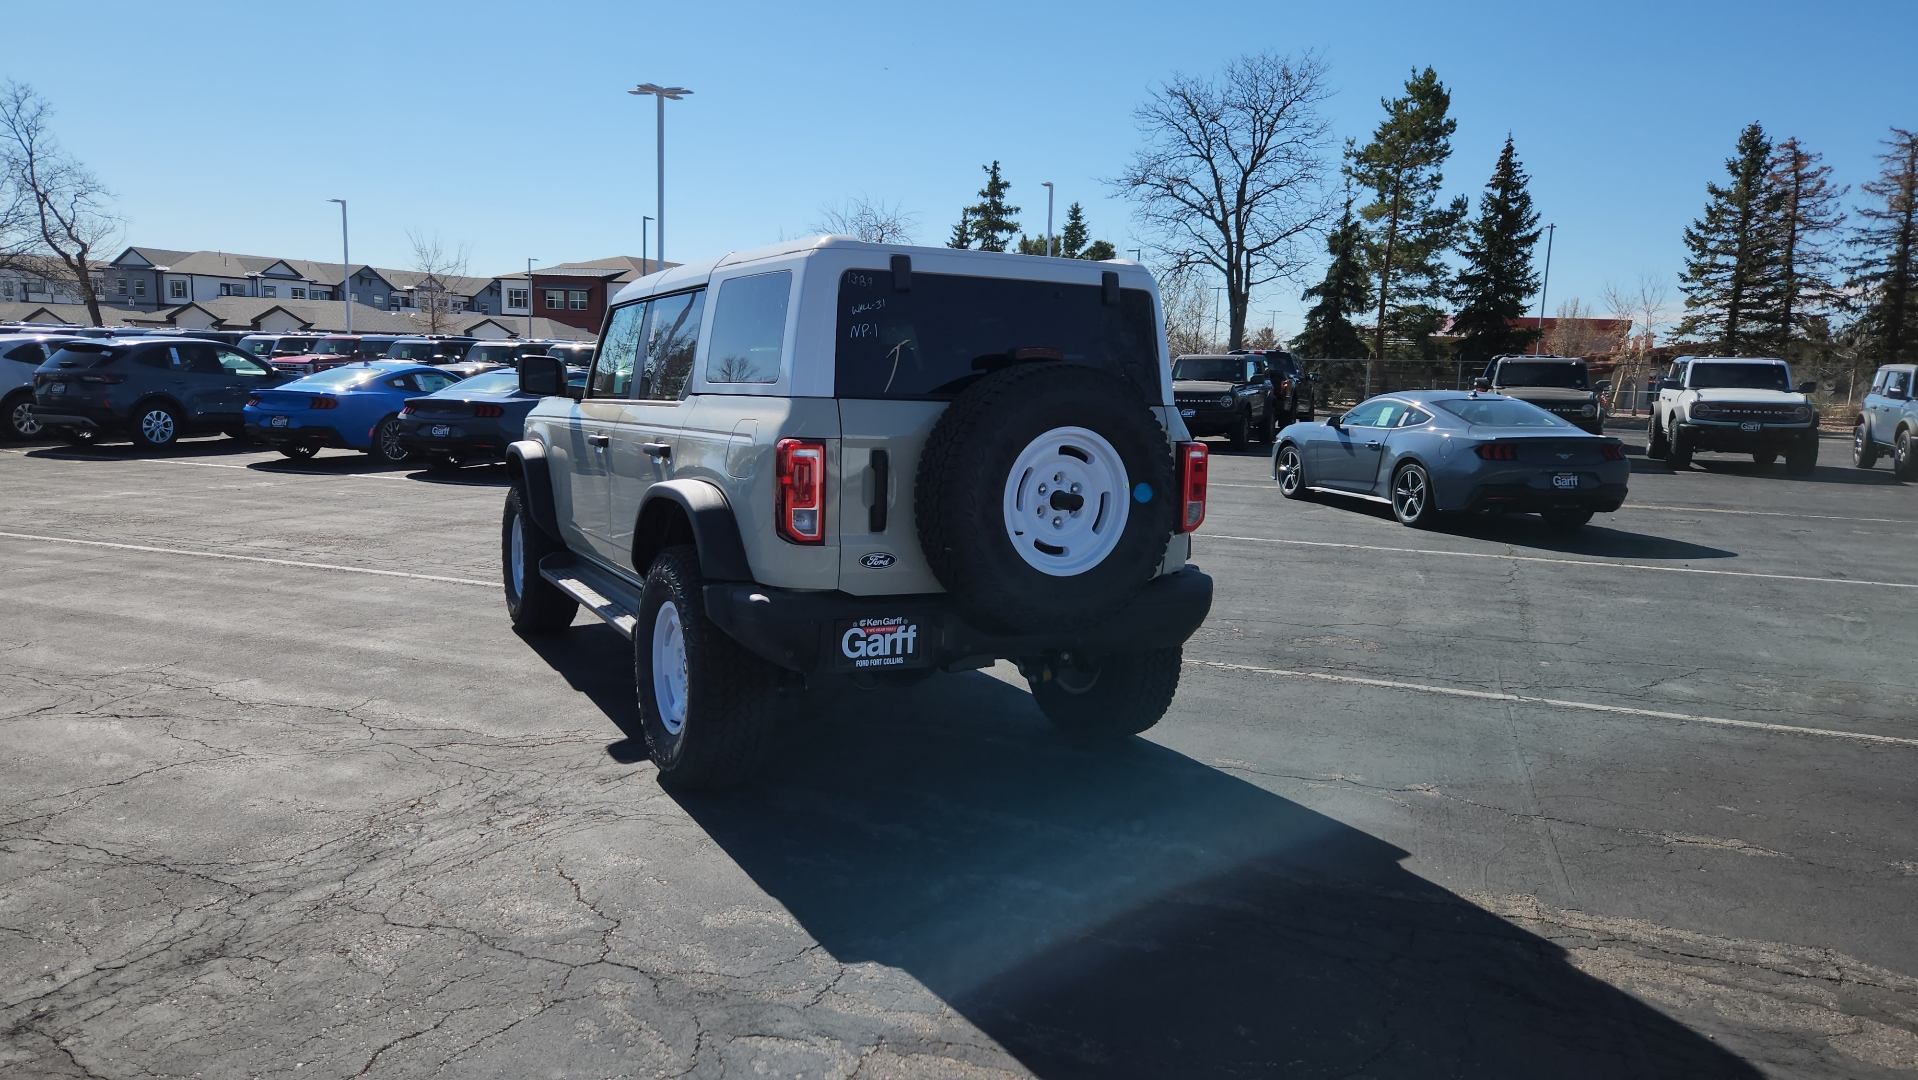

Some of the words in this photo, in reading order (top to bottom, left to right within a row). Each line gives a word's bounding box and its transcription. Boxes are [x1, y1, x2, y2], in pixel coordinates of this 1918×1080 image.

[271, 417, 288, 426] Garff
[1740, 422, 1761, 430] Garff
[431, 426, 451, 436] Garff
[1552, 475, 1579, 486] Garff
[866, 618, 883, 626] Ken
[883, 616, 903, 625] Garff
[841, 624, 917, 659] Garff
[855, 659, 870, 668] FORD
[870, 658, 883, 666] FORT
[883, 657, 904, 666] COLLINS
